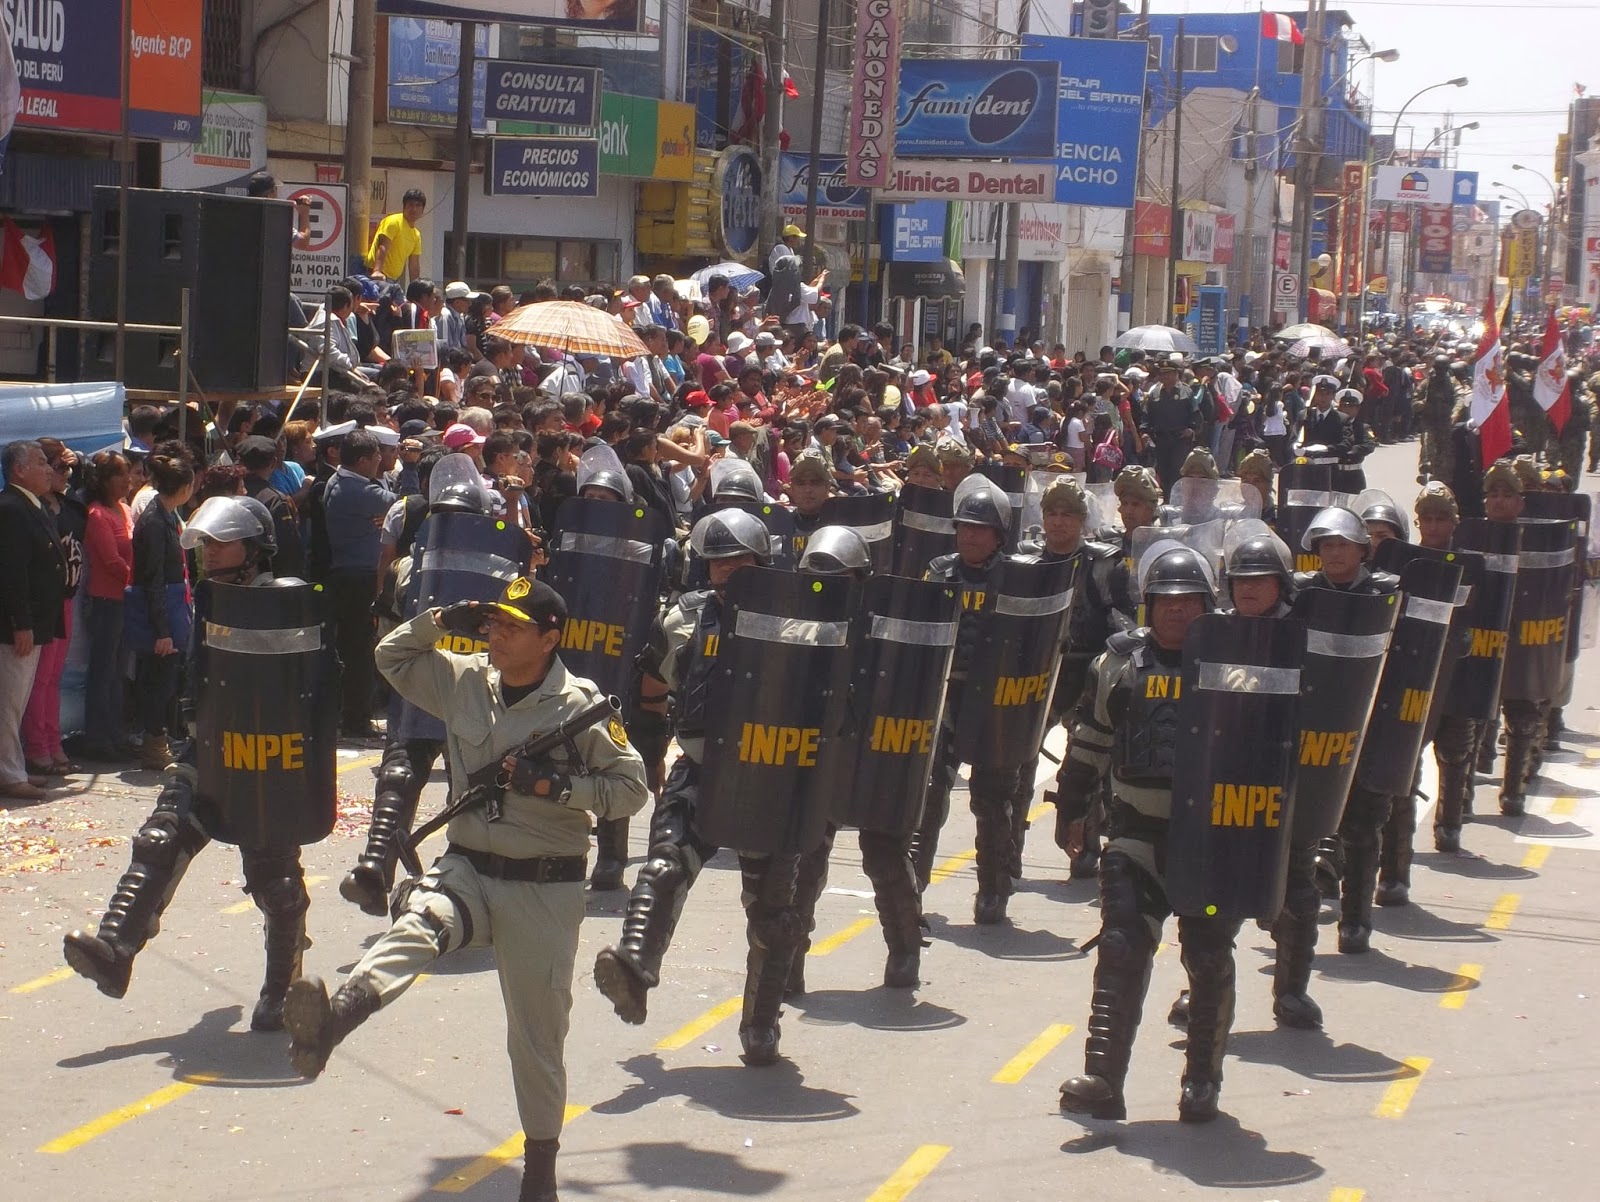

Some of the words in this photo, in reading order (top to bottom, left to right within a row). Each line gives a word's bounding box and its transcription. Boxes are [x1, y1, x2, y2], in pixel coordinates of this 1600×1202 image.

[3, 0, 65, 52] SALUD
[169, 36, 191, 58] BCP
[24, 60, 39, 79] DEL
[500, 71, 585, 94] CONSULTA
[858, 0, 891, 180] GAMONEDAS
[1060, 77, 1100, 89] CAJA
[27, 97, 58, 117] LEGAL
[496, 94, 576, 116] GRATUITA
[897, 83, 1032, 126] famident
[1090, 92, 1141, 105] SANTA
[522, 148, 579, 166] PRECIOS
[502, 168, 589, 188] ECONÓMICOS
[968, 171, 1045, 195] Dental
[831, 209, 865, 218] DOLOR
[307, 264, 340, 276] HORA
[311, 279, 323, 288] 10
[1283, 279, 1292, 291] E
[560, 617, 625, 657] INPE
[1520, 616, 1565, 646] INPE
[993, 672, 1050, 706] INPE
[739, 722, 820, 767] INPE
[871, 715, 934, 754] INPE
[223, 730, 304, 771] INPE
[1300, 730, 1359, 767] INPE
[1211, 783, 1283, 828] INPE
